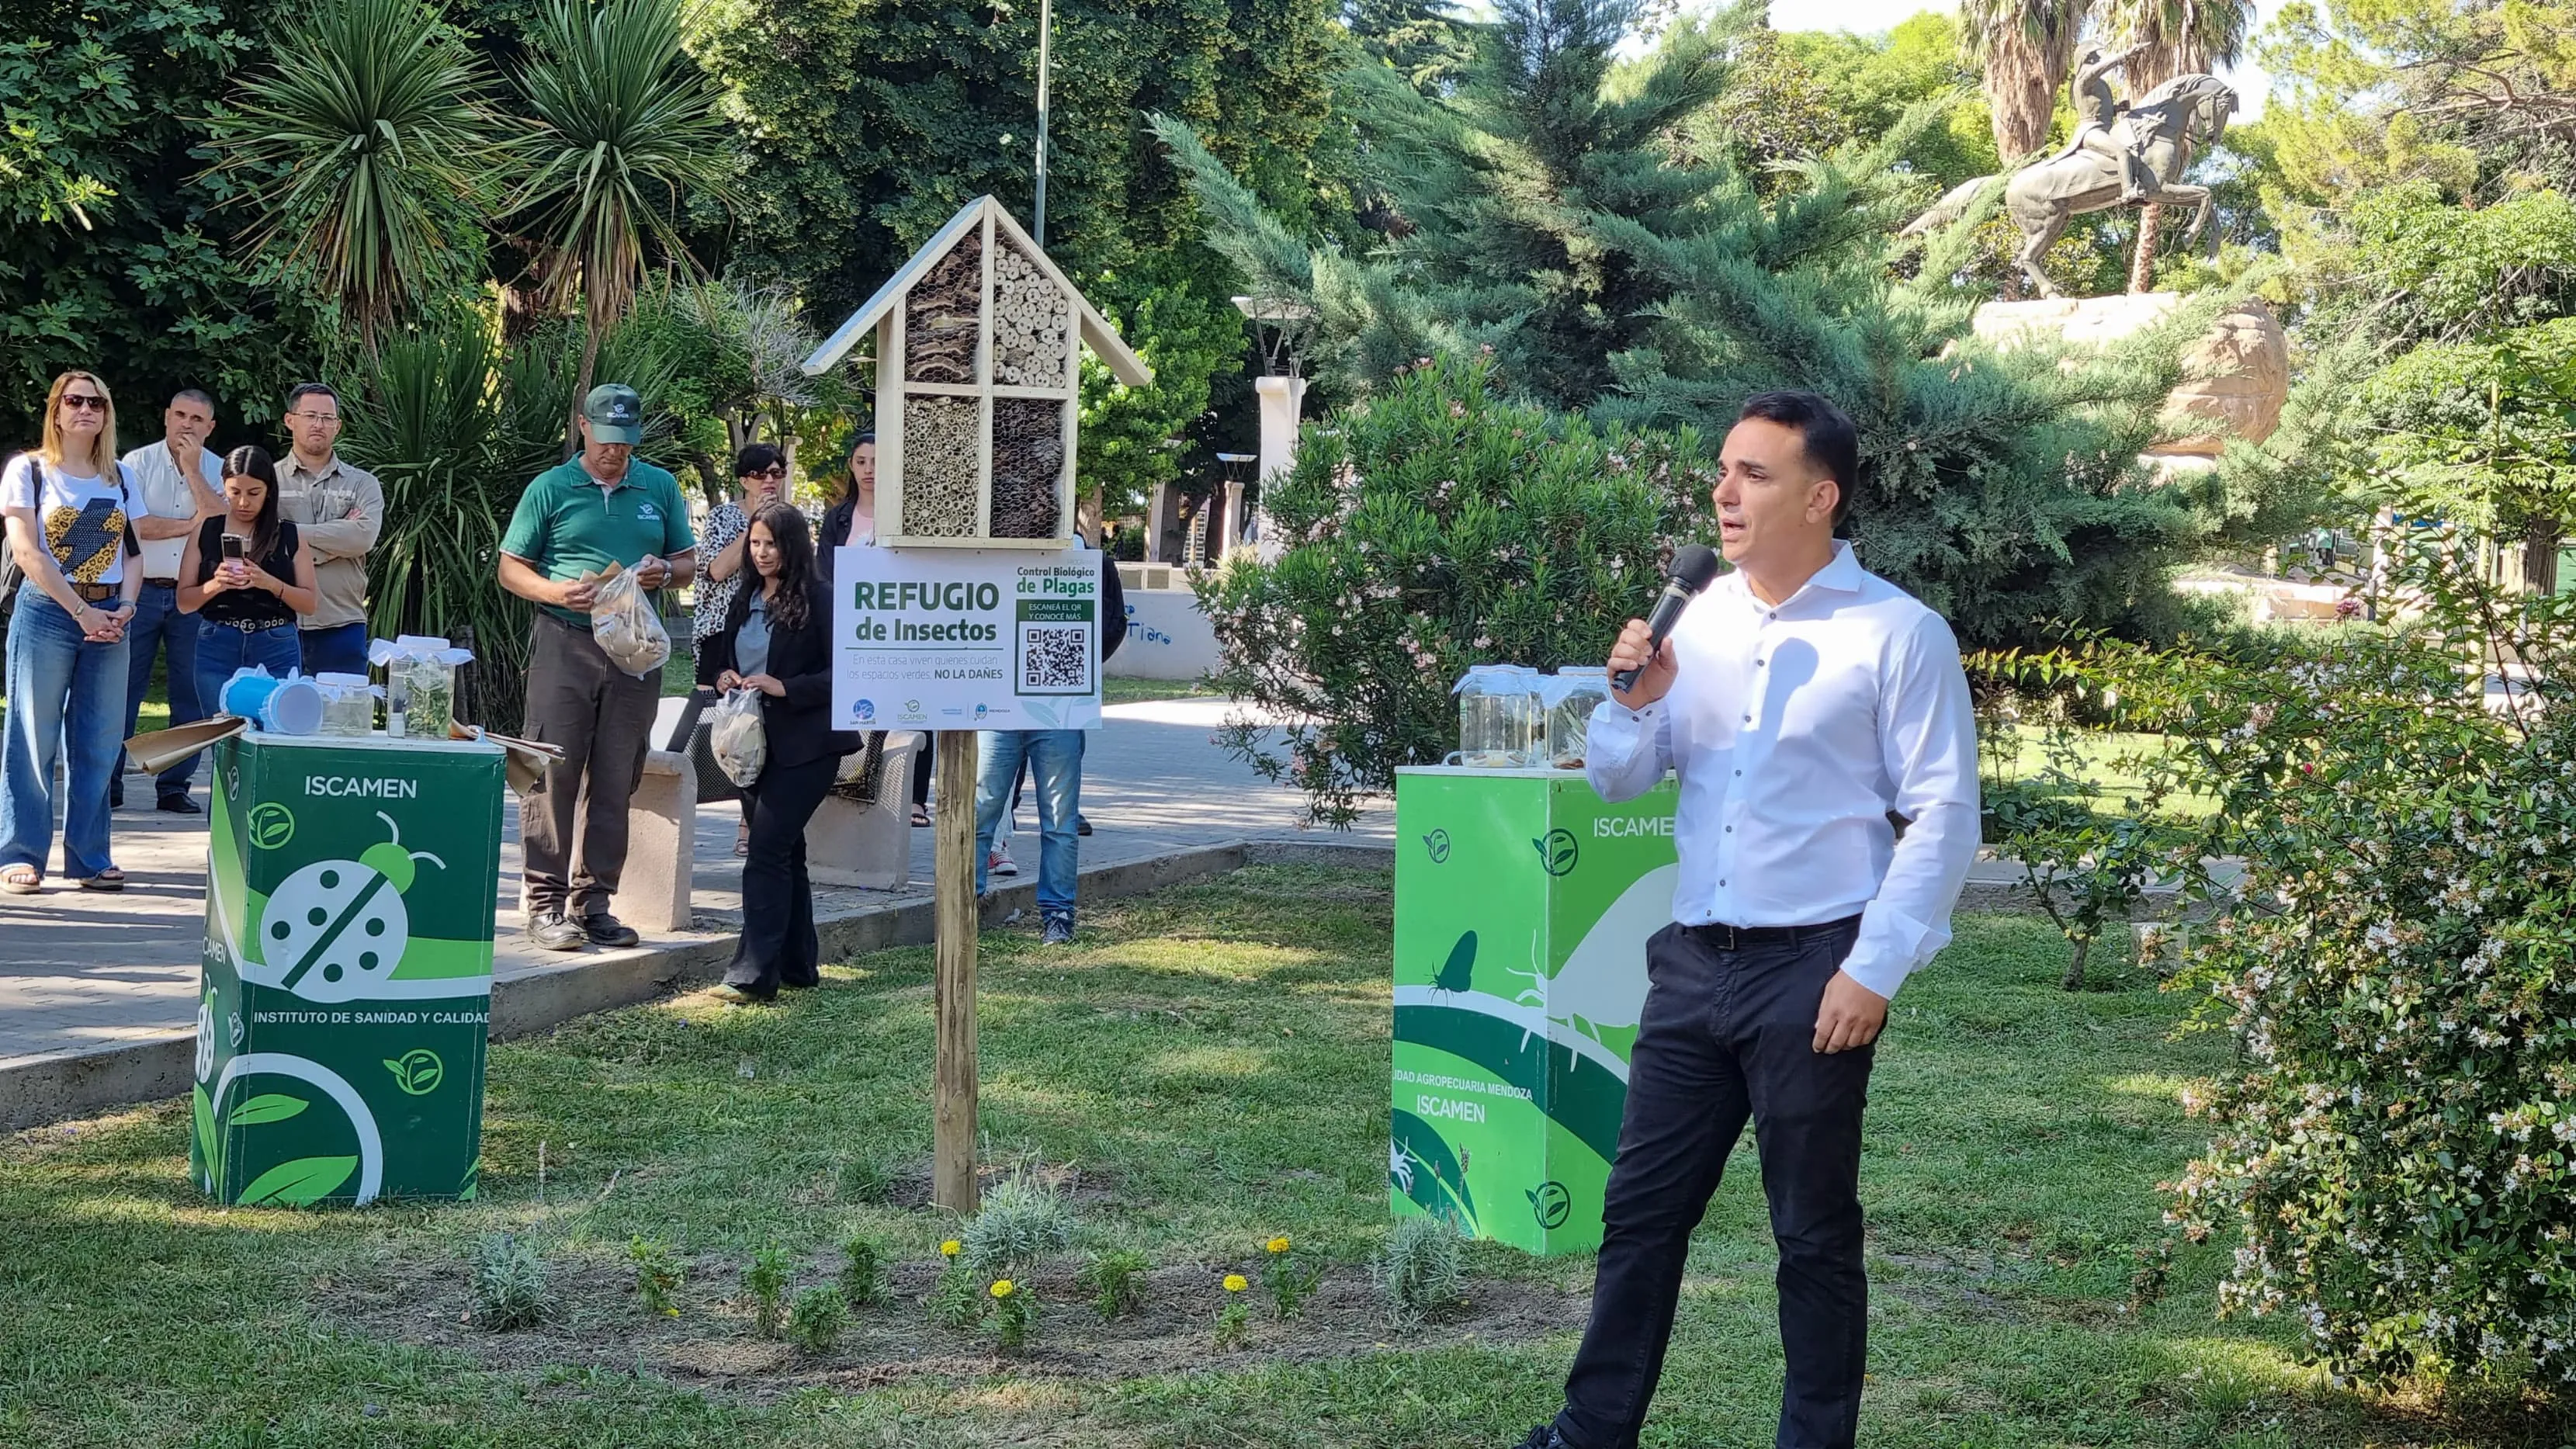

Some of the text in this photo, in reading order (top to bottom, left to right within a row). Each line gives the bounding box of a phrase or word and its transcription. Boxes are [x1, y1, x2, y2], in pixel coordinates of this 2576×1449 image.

[1018, 567, 1094, 578] Control Biológico
[855, 581, 1000, 611] REFUGIO
[1017, 577, 1094, 598] de Plagas
[1028, 601, 1060, 611] ESCANEÁ
[1066, 612, 1081, 620] MÁS
[856, 616, 997, 641] de Insectos
[853, 655, 864, 665] En
[867, 655, 886, 665] esta
[910, 655, 931, 665] viven
[934, 655, 968, 667] quienes
[969, 655, 998, 665] cuidan
[847, 670, 861, 679] los
[862, 670, 899, 681] espacios
[934, 669, 950, 679] NO
[952, 669, 966, 679] LA
[969, 667, 1004, 679] DAÑES
[304, 776, 417, 799] ISCAMEN
[1593, 817, 1675, 837] ISCAME
[203, 936, 227, 965] CAMEN
[254, 1011, 328, 1023] INSTITUTO
[331, 1012, 351, 1024] DE
[354, 1011, 418, 1024] SANIDAD
[421, 1012, 430, 1024] Y
[1416, 1073, 1486, 1094] AGROPECUARIA
[1487, 1083, 1533, 1101] MENDOZA
[1416, 1094, 1486, 1124] ISCAMEN
